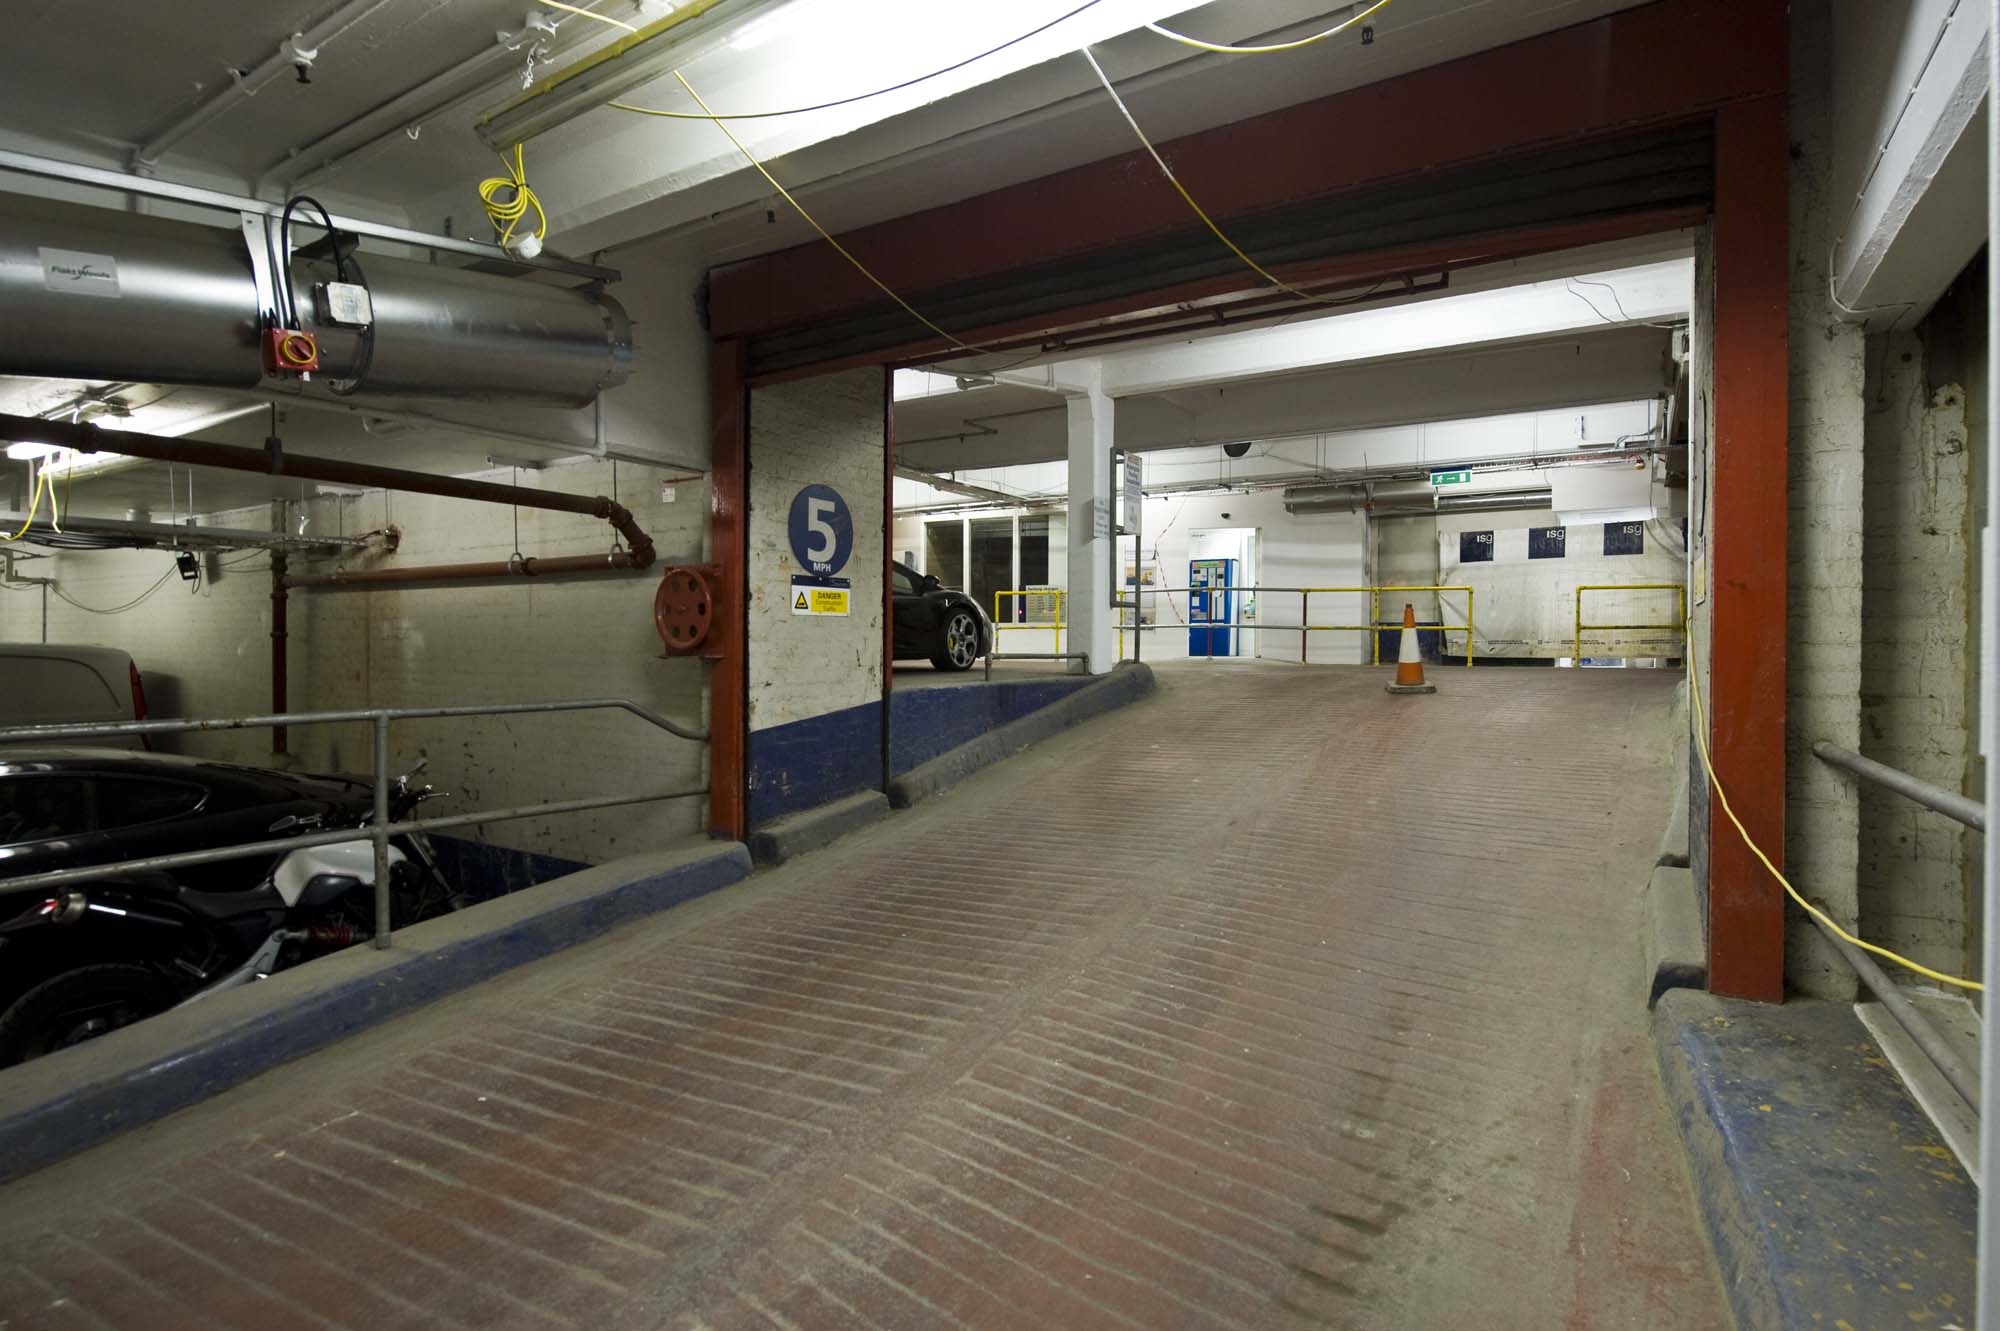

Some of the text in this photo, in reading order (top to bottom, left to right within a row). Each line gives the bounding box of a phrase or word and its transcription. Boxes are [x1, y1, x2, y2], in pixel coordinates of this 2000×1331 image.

[808, 496, 836, 563] 5
[1546, 529, 1564, 540] isg
[1623, 525, 1641, 535] isg
[1476, 534, 1493, 544] isg
[813, 562, 831, 572] MPH
[817, 591, 842, 600] DANGER
